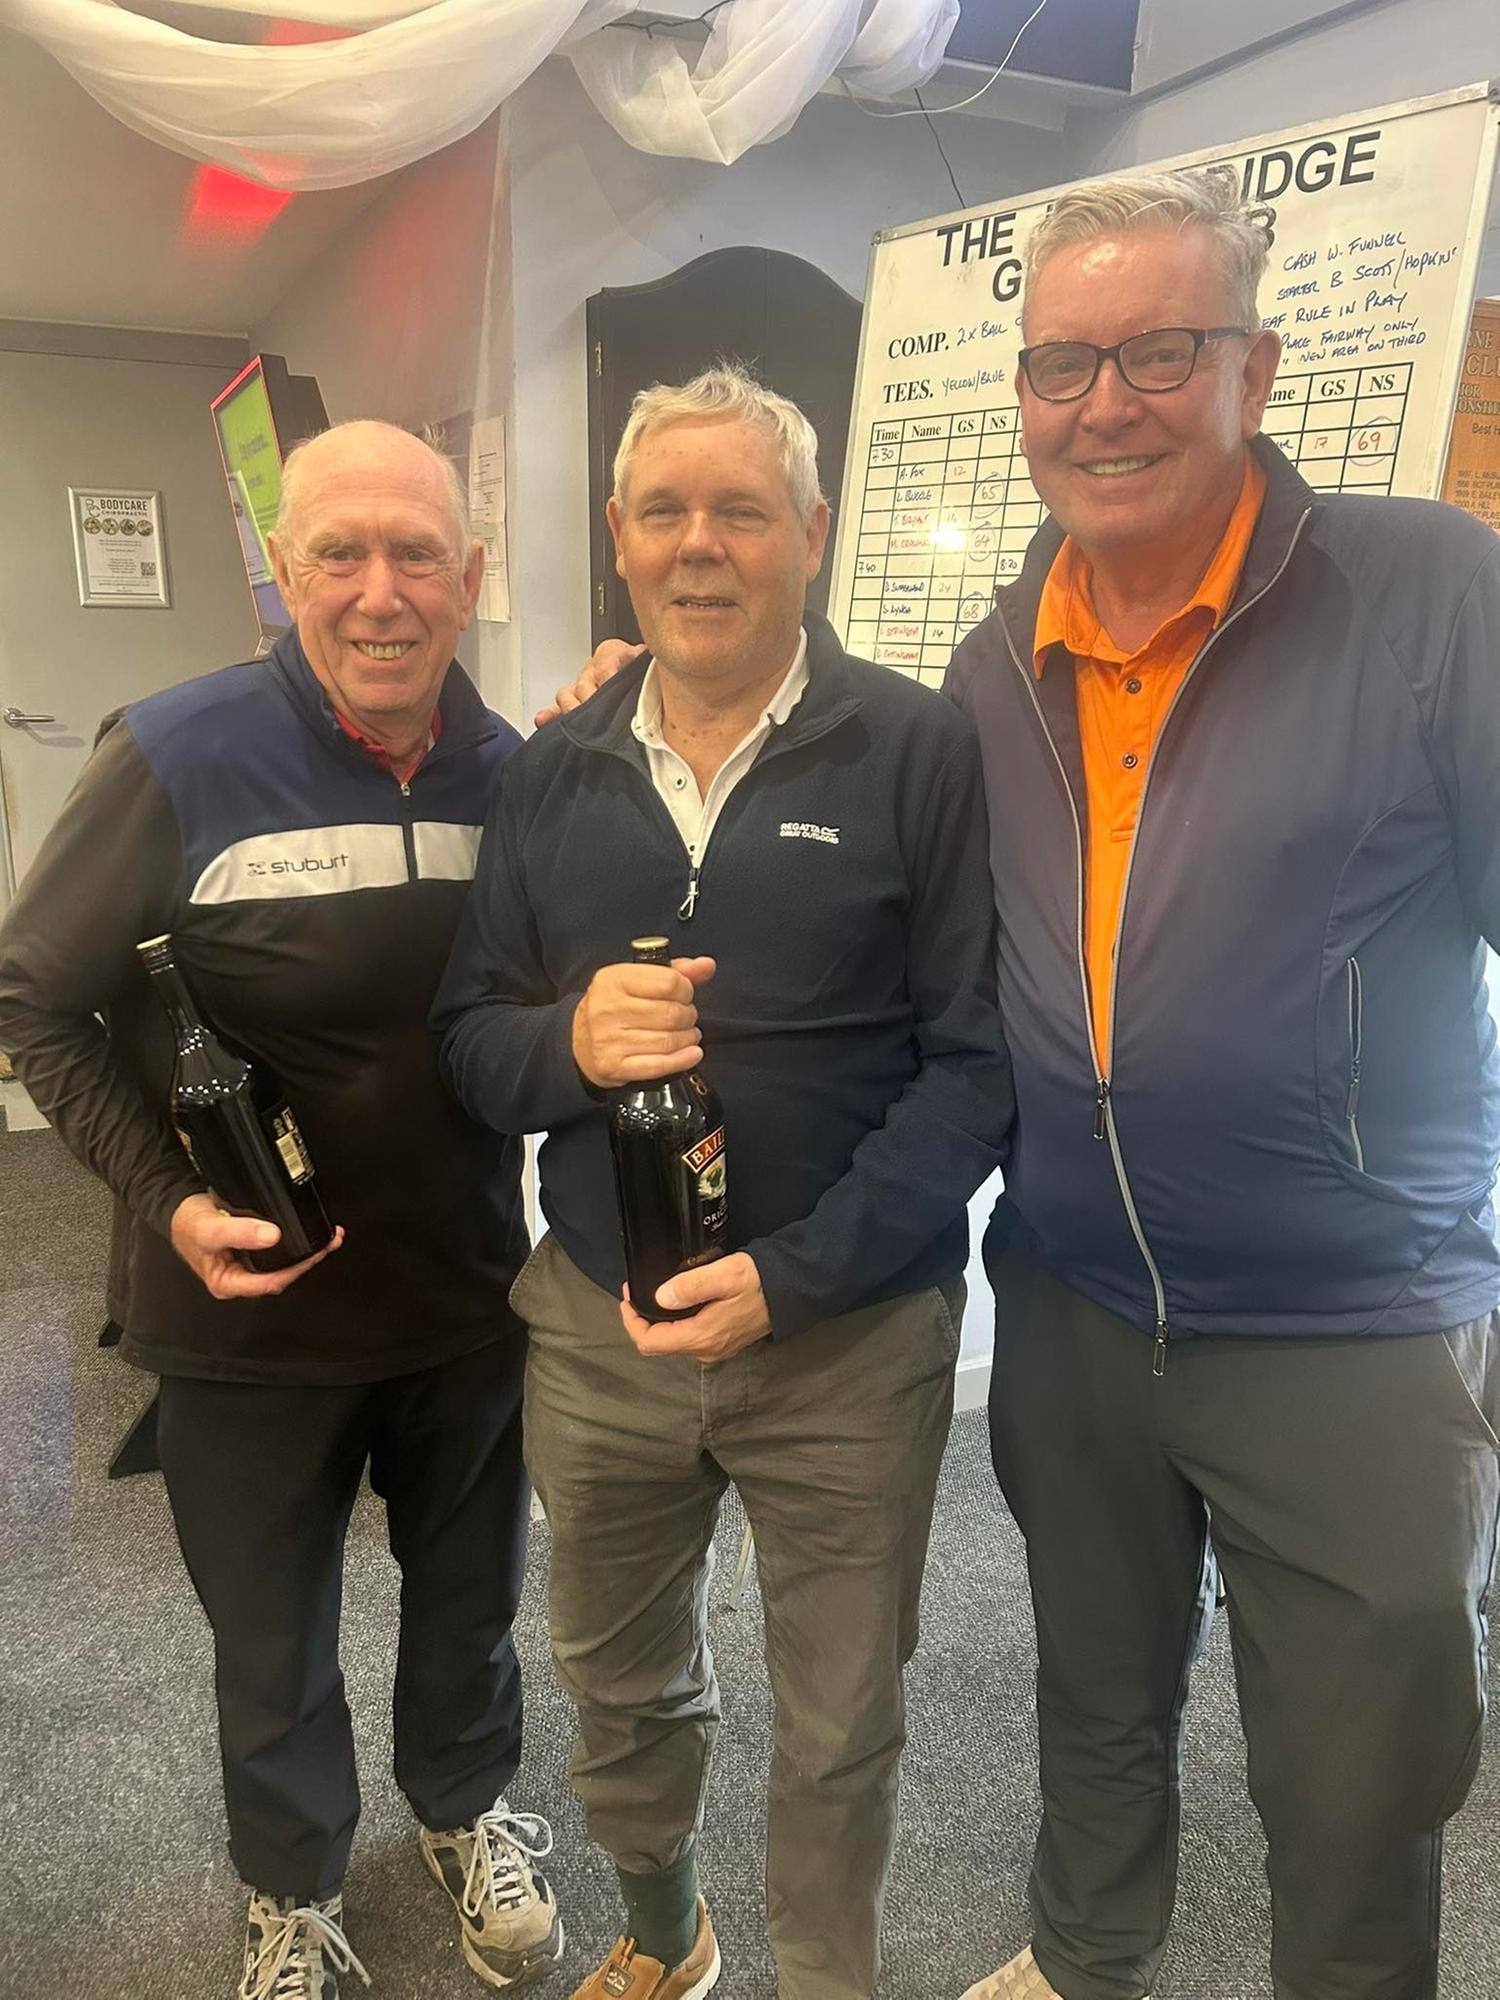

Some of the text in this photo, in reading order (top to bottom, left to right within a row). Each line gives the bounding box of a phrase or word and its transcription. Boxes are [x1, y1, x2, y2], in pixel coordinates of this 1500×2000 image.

[936, 130, 1382, 266] THE IDGE
[1283, 250, 1317, 271] CASH
[1261, 290, 1408, 329] EAF RULE IN PLAY
[888, 332, 949, 359] COMP.
[1300, 351, 1326, 363] NEW
[1367, 339, 1385, 351] ON
[883, 379, 933, 404] TEES.
[1320, 379, 1346, 397] GS
[1369, 374, 1395, 392] NS
[874, 416, 1008, 442] Time Name GS NS
[1357, 431, 1381, 452] 69
[981, 483, 1001, 500] 65
[100, 499, 147, 511] BODYCARE
[963, 603, 981, 619] 68
[270, 853, 349, 874] stuburt
[691, 1129, 725, 1165] BAIL
